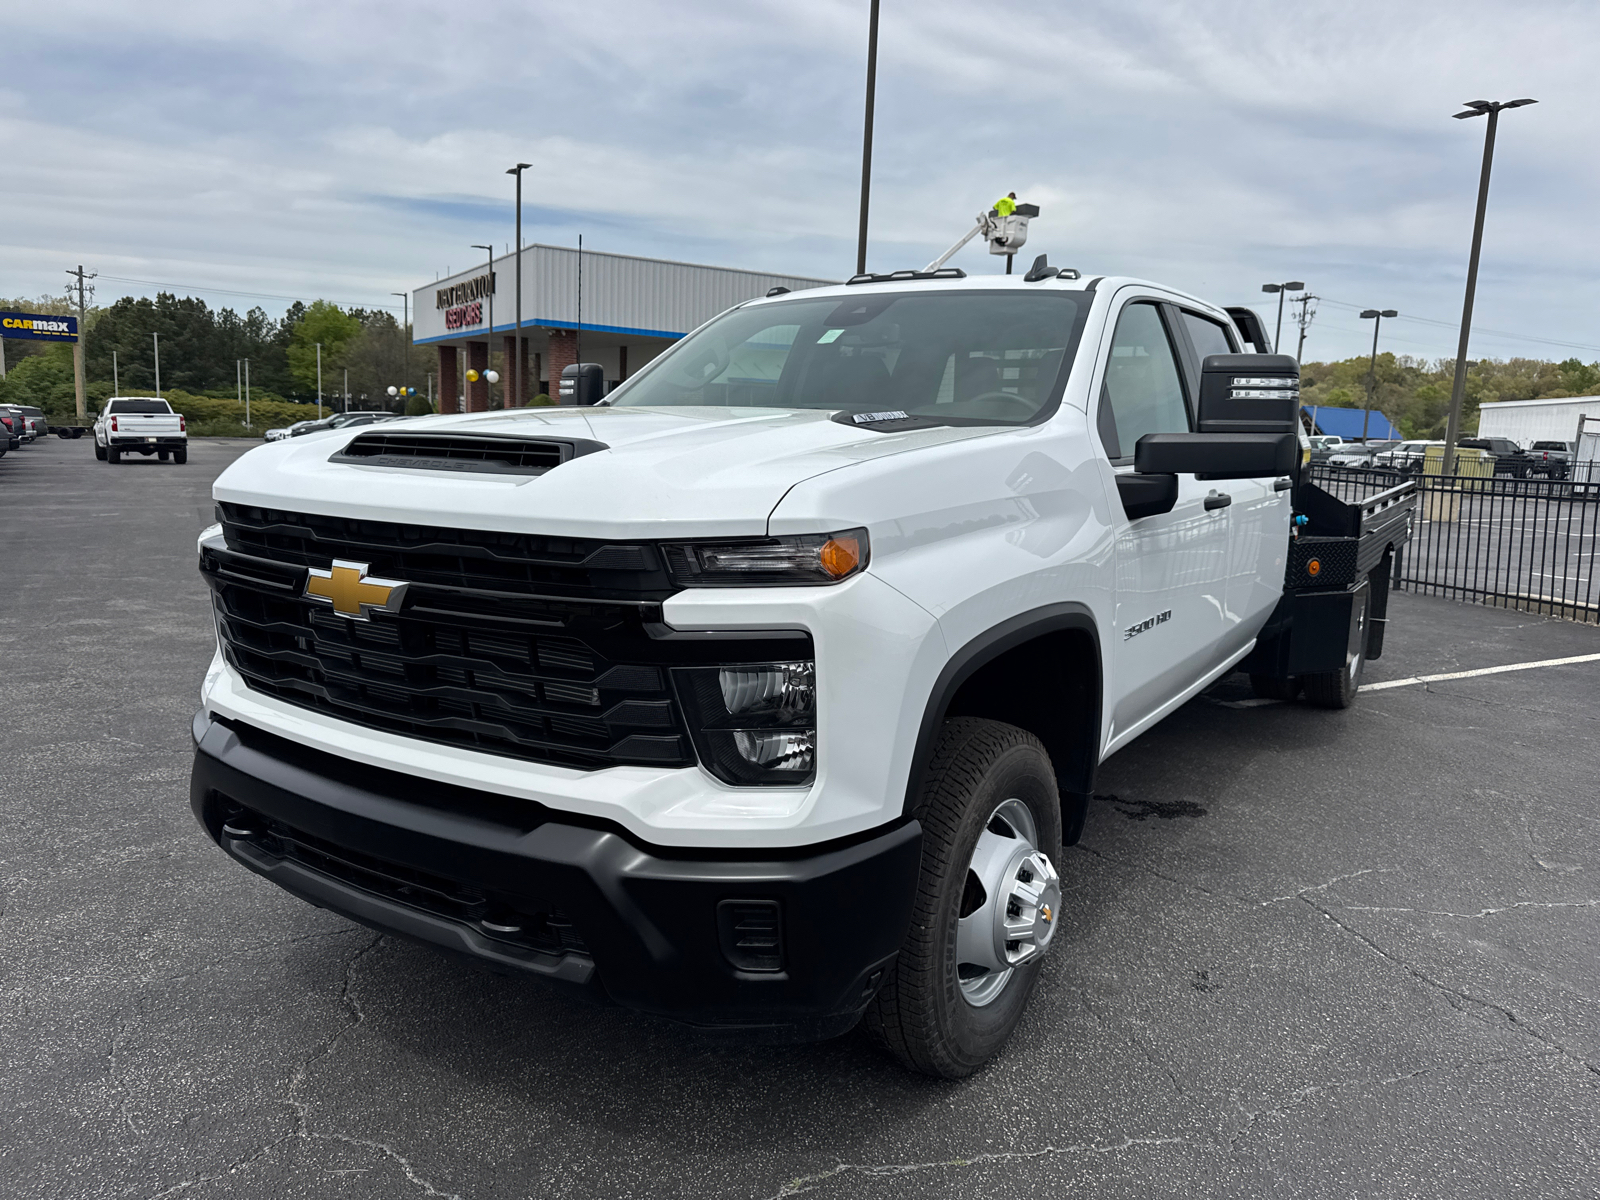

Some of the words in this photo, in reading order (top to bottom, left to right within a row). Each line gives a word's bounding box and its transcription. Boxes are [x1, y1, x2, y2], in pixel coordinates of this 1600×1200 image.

[445, 307, 461, 329] USED
[461, 302, 482, 326] CARS
[377, 457, 478, 470] CHEVROLET
[1124, 616, 1154, 641] 3500
[1156, 609, 1171, 626] HD
[945, 889, 960, 1004] MICHELIN
